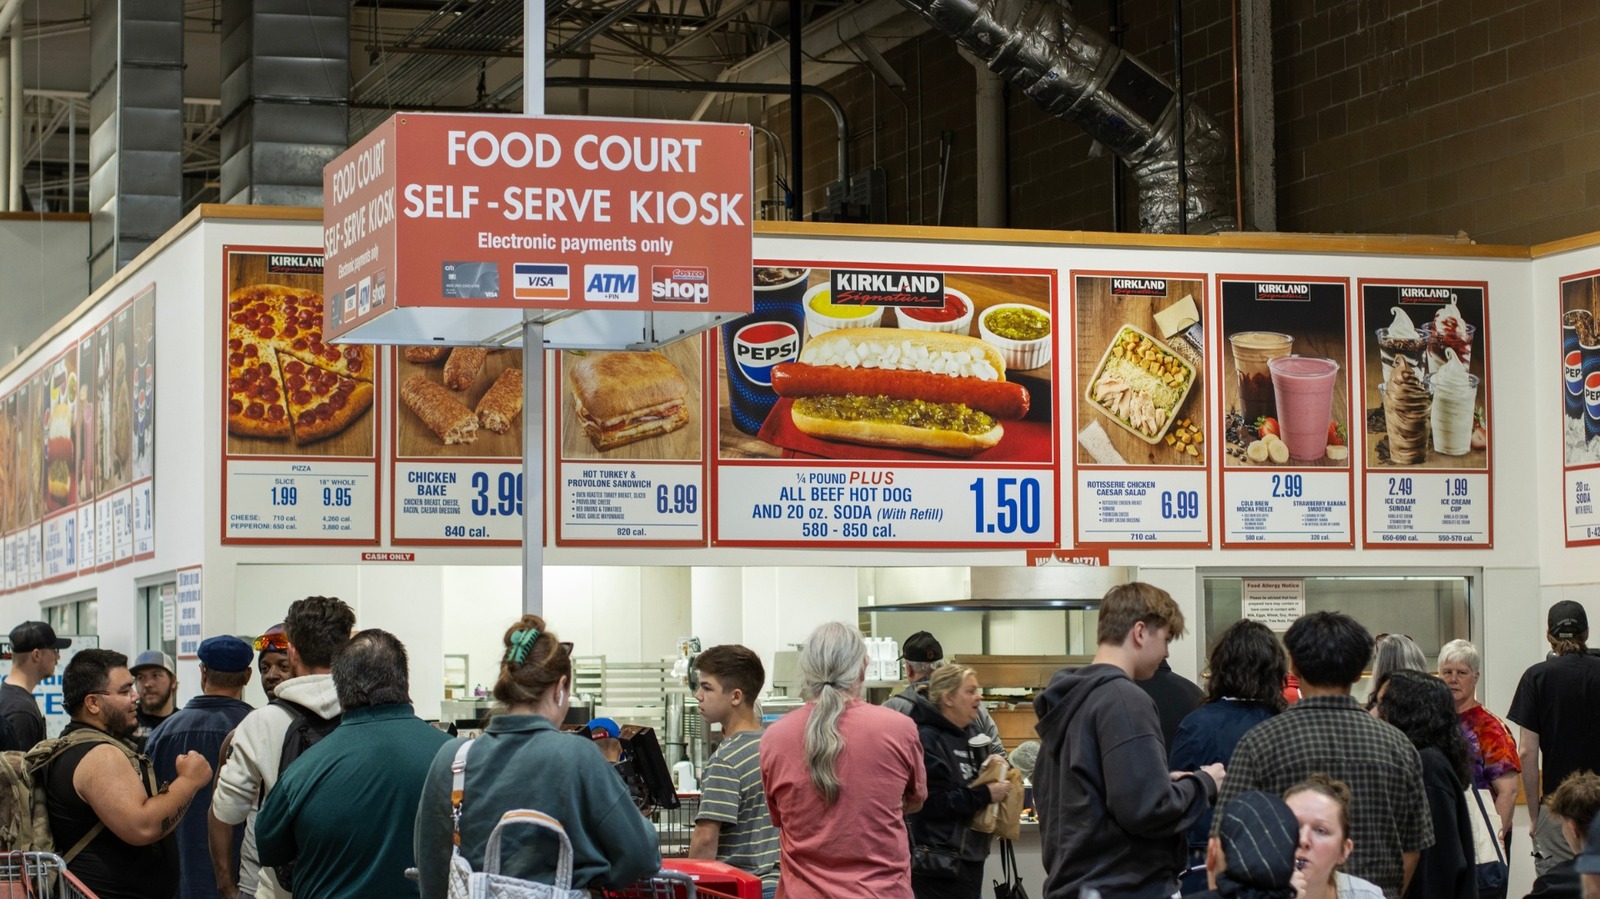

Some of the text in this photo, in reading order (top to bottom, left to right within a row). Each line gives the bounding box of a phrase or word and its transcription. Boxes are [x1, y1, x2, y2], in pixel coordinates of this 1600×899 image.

[448, 130, 702, 173] FOOD COURT
[333, 138, 385, 206] FOOD COURT
[369, 187, 394, 234] KIOSK
[630, 190, 745, 226] KIOSK
[478, 232, 673, 256] Electronic payments only
[271, 256, 324, 267] KIRKLAN
[674, 269, 704, 277] COSTCO
[528, 277, 554, 286] VISA
[586, 273, 636, 293] ATM
[837, 274, 940, 293] KIRKLAND
[1114, 279, 1165, 289] KIRKLAND
[1259, 284, 1308, 294] KIRKLAND
[652, 278, 708, 303] shop
[837, 290, 940, 306] Signature
[1401, 288, 1450, 298] KIRKLAND
[737, 340, 796, 360] PEPSI
[1566, 367, 1582, 378] PEP
[1586, 389, 1600, 401] PEP
[408, 471, 456, 484] CHICKEN
[583, 470, 597, 478] HOT
[810, 471, 894, 485] POUND PLUS
[418, 485, 446, 496] BAKE
[568, 479, 651, 488] PROVOLONE SANDWICH
[1272, 474, 1302, 497] 2.99
[1389, 478, 1412, 495] 2.49
[1445, 478, 1467, 496] 1.99
[1576, 482, 1583, 492] 20
[271, 487, 297, 505] 1.99
[323, 487, 352, 506] 9.95
[656, 484, 697, 514] 6.99
[780, 487, 912, 502] ALL BEEF HOT DOG
[1576, 493, 1591, 504] SODA
[970, 477, 1040, 534] 1.50
[1161, 491, 1199, 519] 6.99
[752, 505, 943, 522] AND 20 oz. SODA (With Refill)
[445, 526, 490, 537] 840 cal.
[617, 528, 630, 536] 820
[802, 523, 828, 537] 580
[843, 523, 867, 537] 850
[872, 524, 896, 538] cal.
